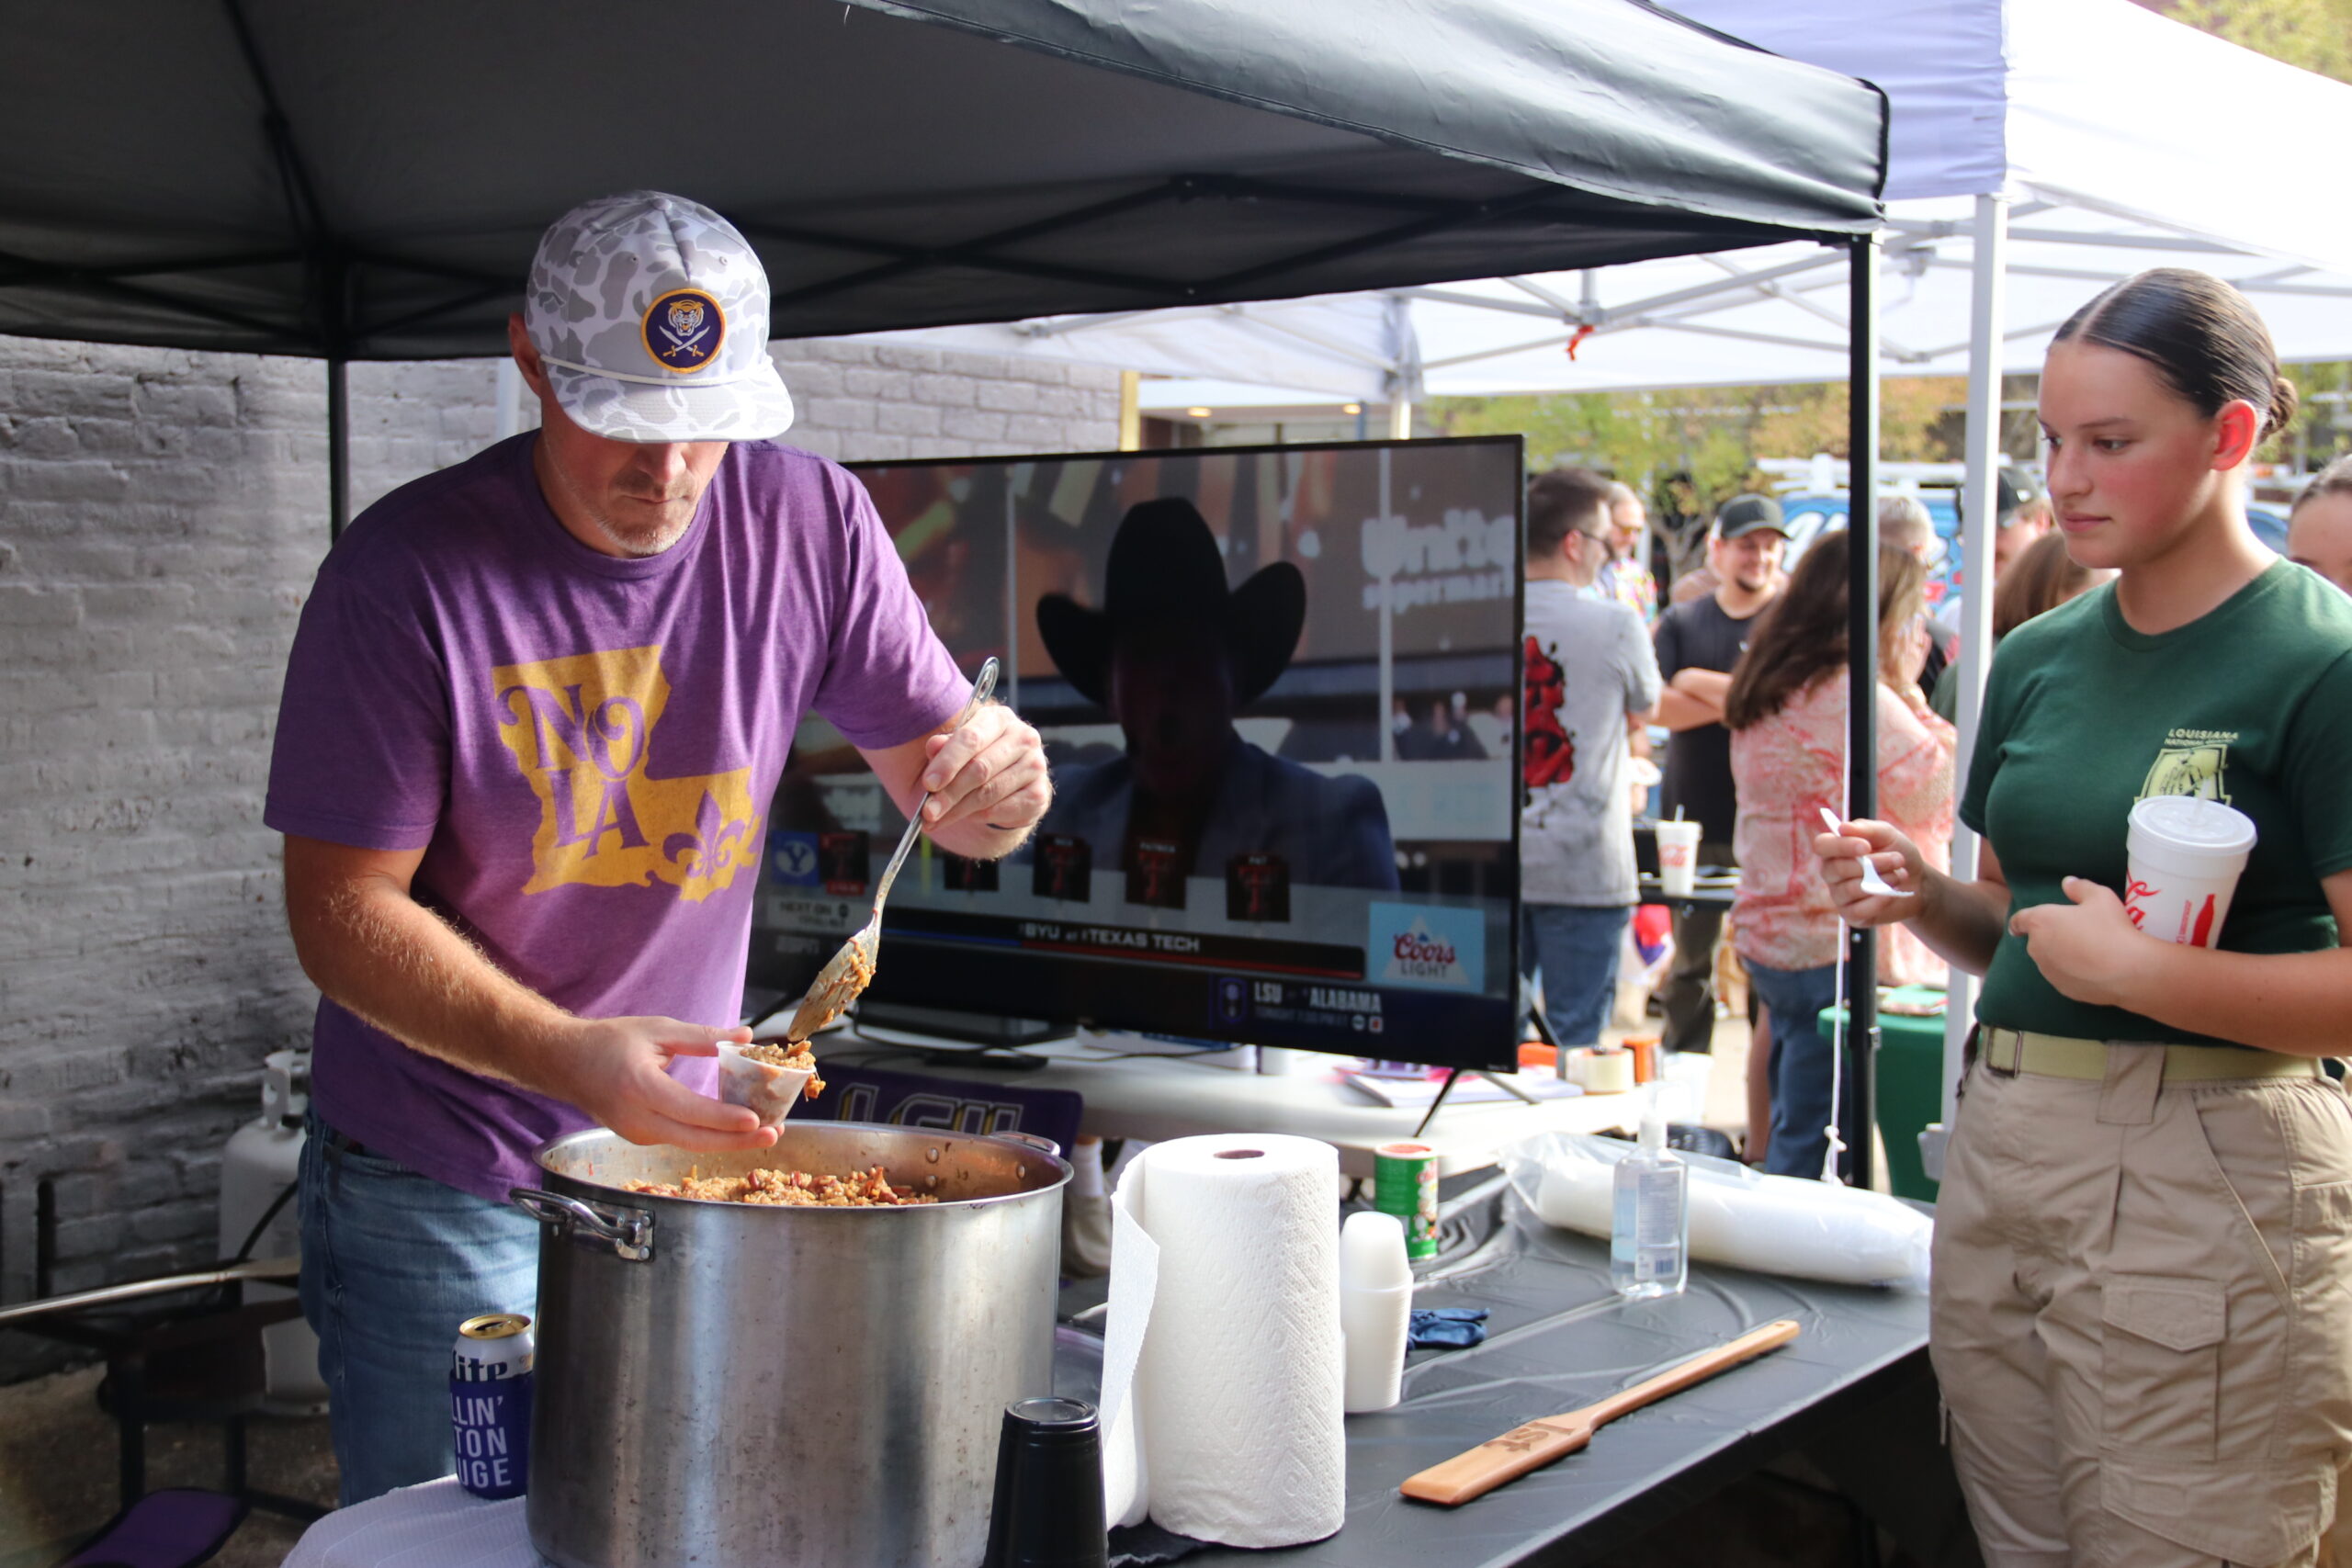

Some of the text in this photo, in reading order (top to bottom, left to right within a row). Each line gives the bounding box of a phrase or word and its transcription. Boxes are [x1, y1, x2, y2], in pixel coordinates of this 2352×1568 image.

[2168, 728, 2239, 740] LOUISIANA
[1024, 922, 1059, 940] BYU
[1089, 928, 1147, 948] TEXAS
[1151, 933, 1200, 952] TECH
[1394, 932, 1456, 964] Coors
[1401, 959, 1447, 978] LIGHT
[1254, 981, 1283, 1004] LSU
[1309, 987, 1382, 1014] ALABAMA
